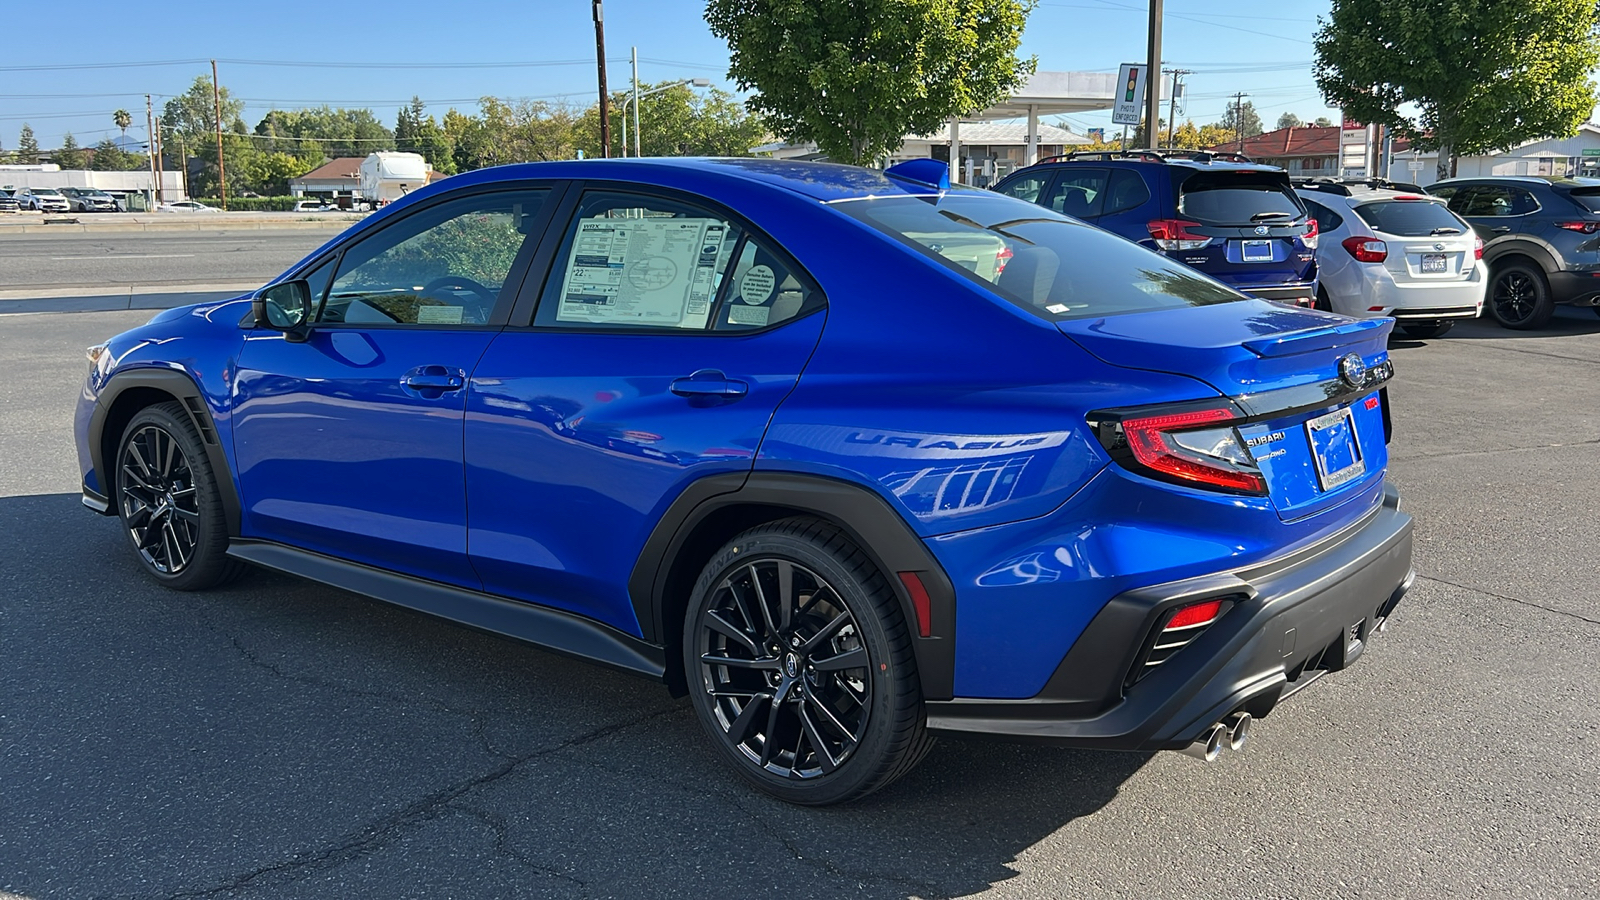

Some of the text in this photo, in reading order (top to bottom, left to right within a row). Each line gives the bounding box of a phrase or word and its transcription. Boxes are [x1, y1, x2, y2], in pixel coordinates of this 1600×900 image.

[1115, 113, 1138, 121] ENFORCED
[1246, 432, 1286, 447] SUBARU
[1270, 448, 1287, 458] AWD
[701, 541, 756, 591] DUNLOP
